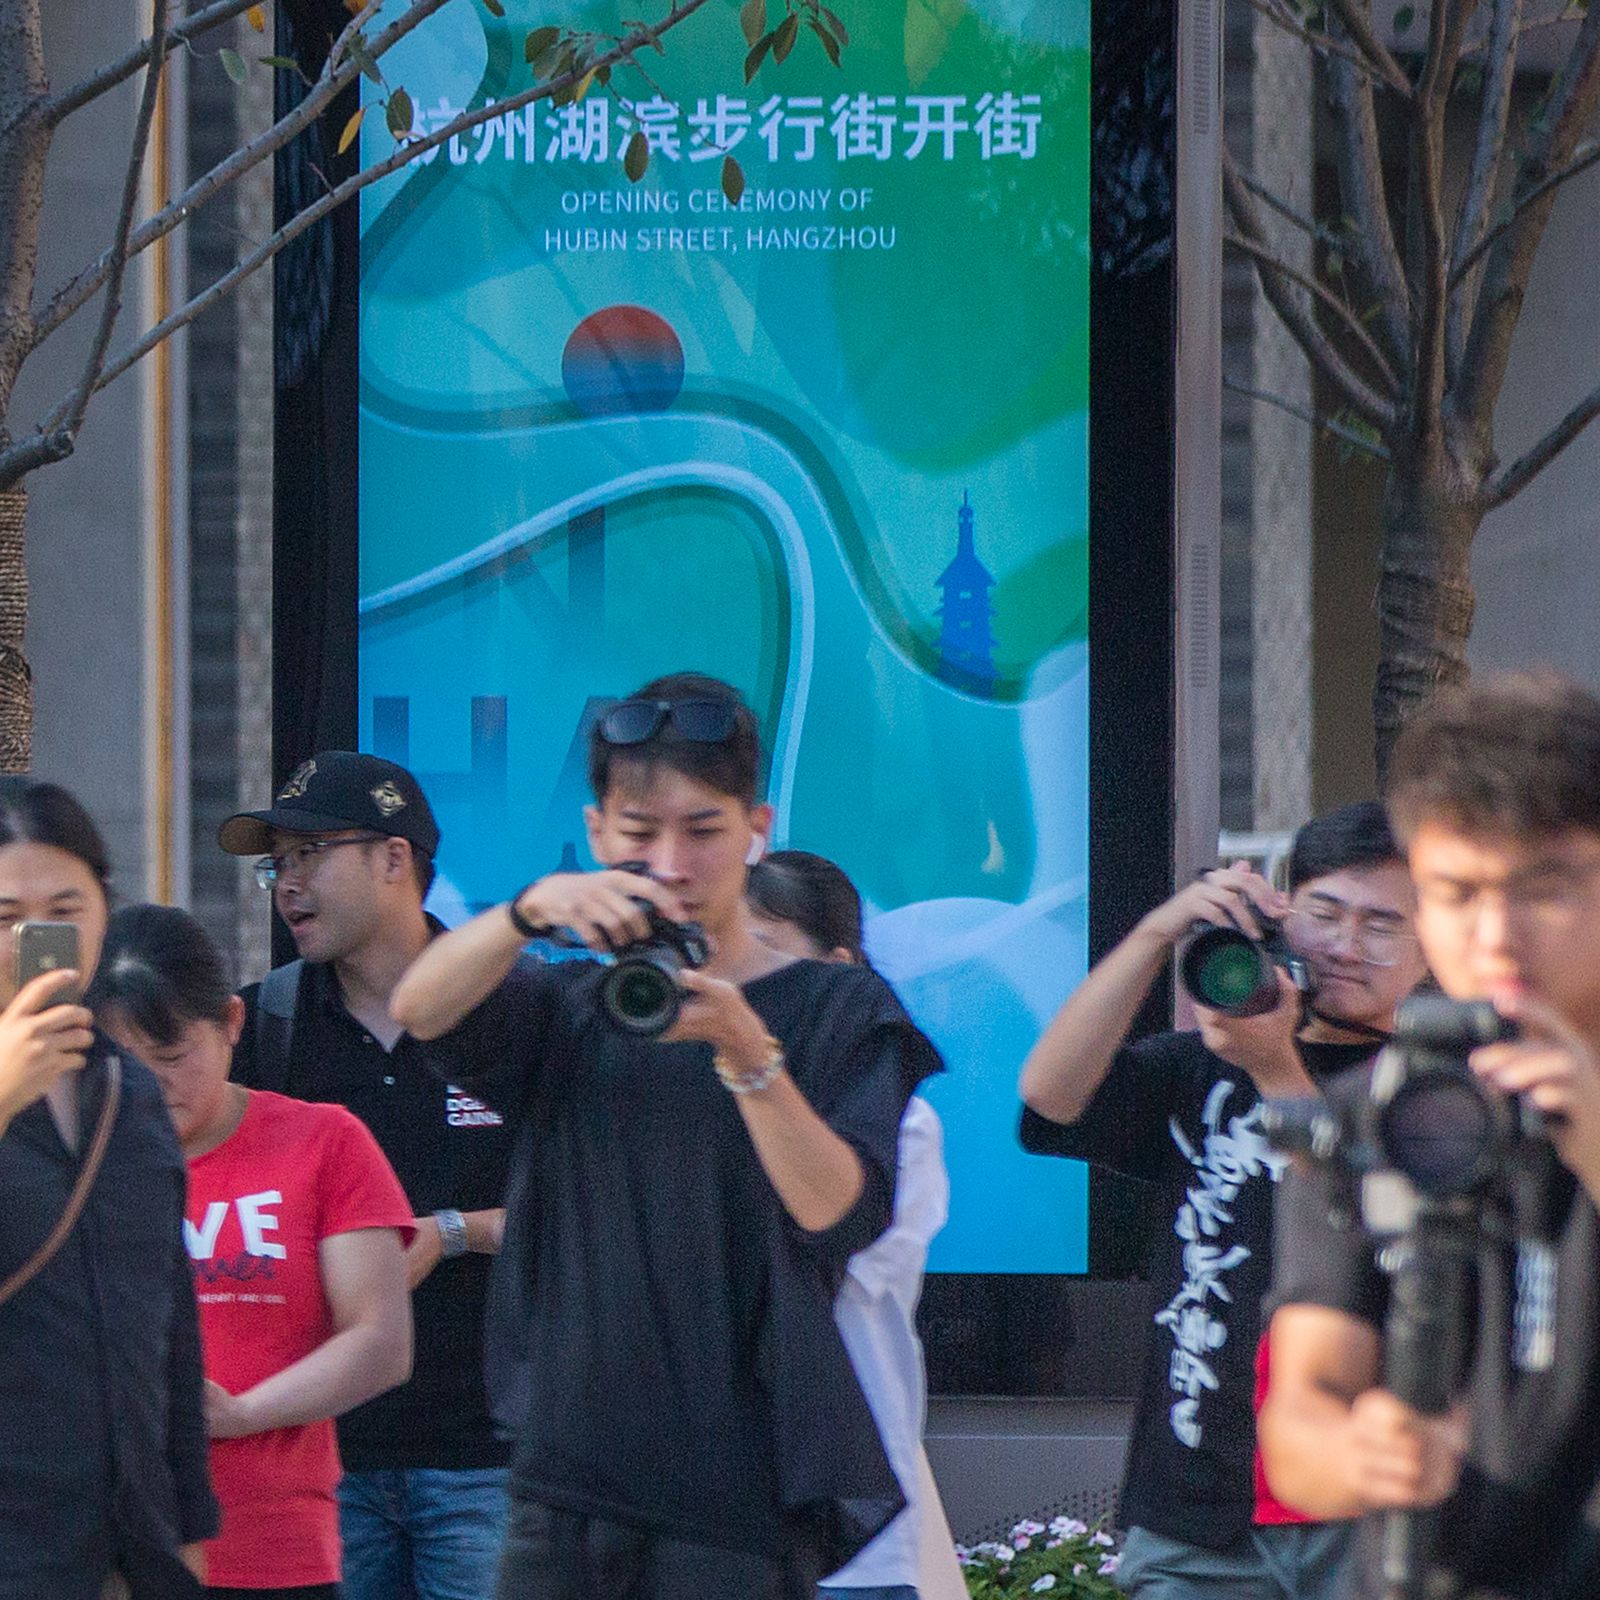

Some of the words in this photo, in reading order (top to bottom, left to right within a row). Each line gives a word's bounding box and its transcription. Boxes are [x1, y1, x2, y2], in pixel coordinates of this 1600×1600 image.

[561, 189, 680, 215] OPENING
[838, 187, 874, 213] OF
[544, 227, 628, 252] HUBIN
[636, 226, 738, 255] STREET,
[747, 225, 896, 250] HANGZHOU
